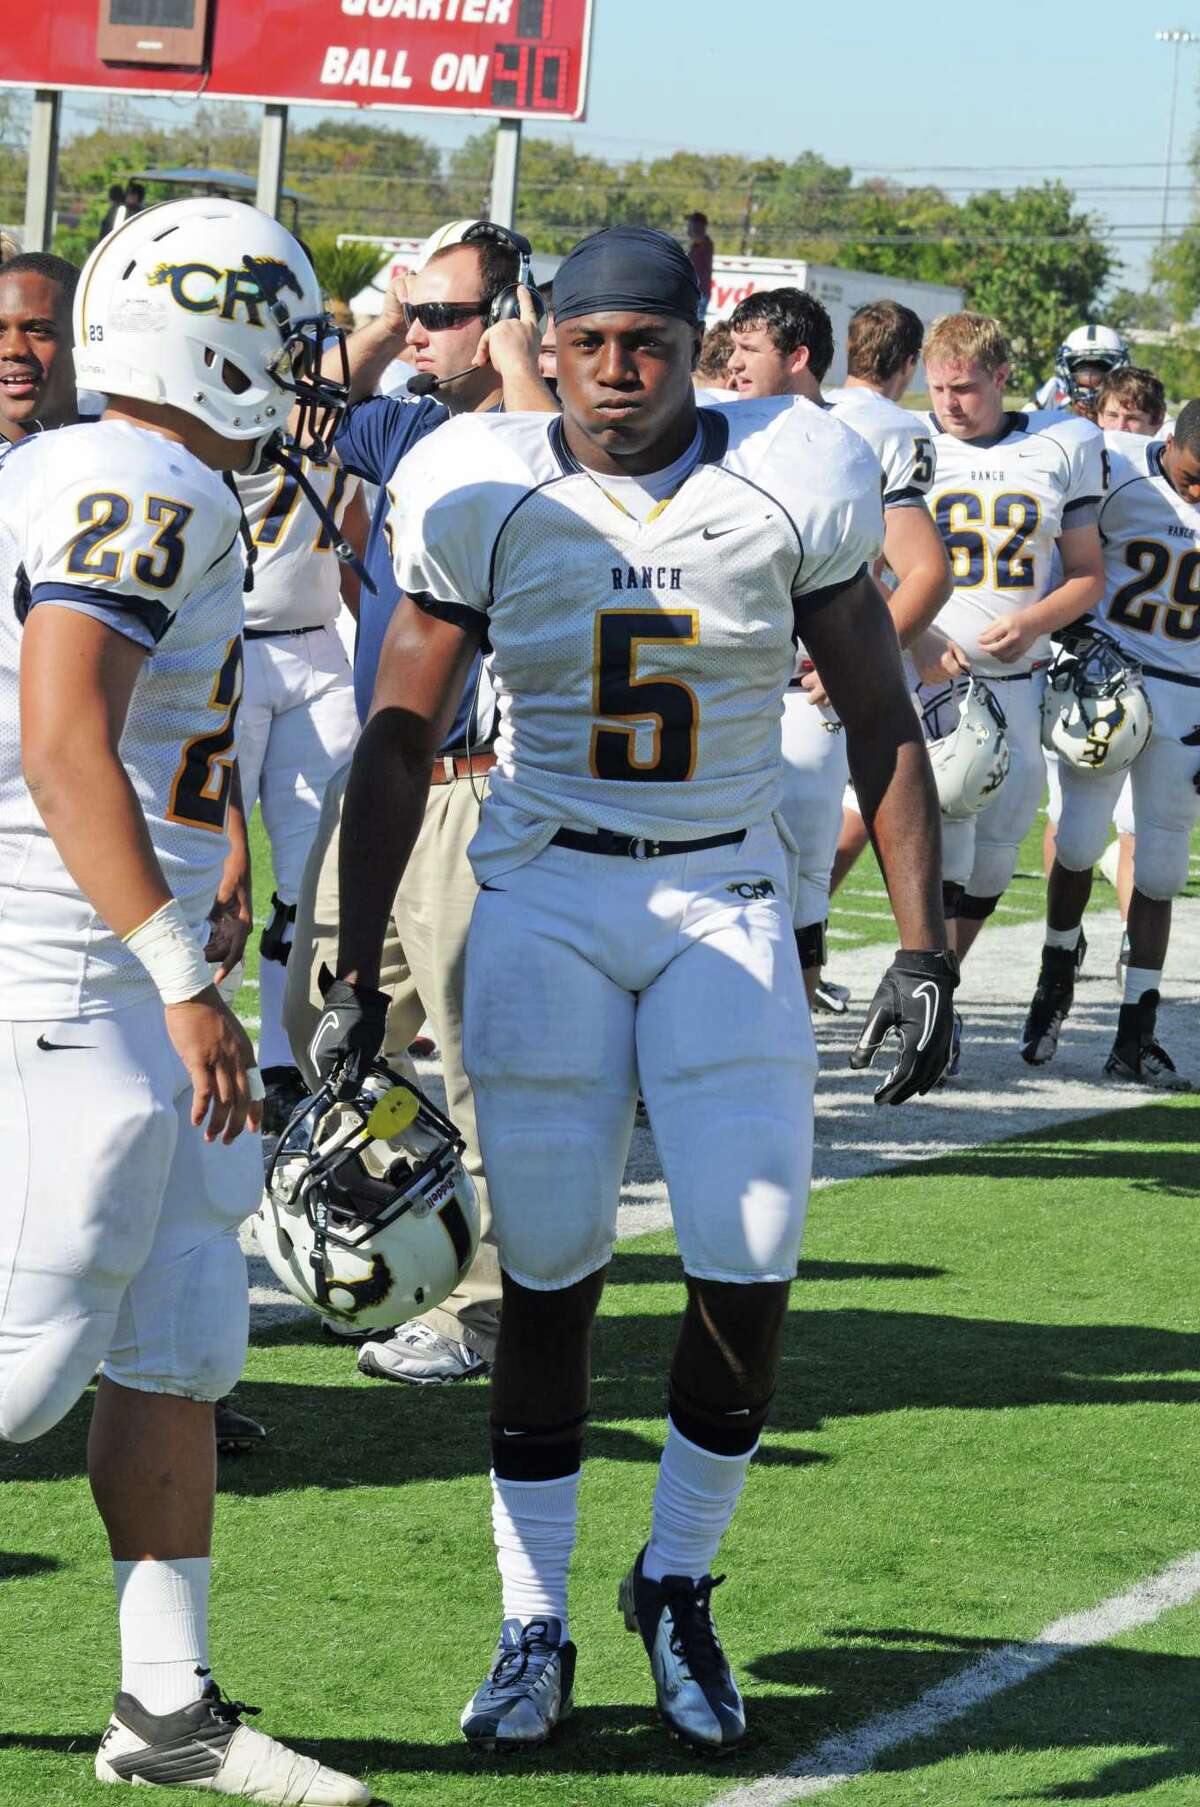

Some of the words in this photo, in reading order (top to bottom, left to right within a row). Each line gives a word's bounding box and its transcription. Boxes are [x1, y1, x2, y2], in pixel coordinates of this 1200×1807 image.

[320, 46, 413, 89] BALL
[430, 53, 489, 93] ON
[493, 46, 568, 109] 40
[89, 325, 104, 342] 23
[971, 471, 1006, 481] RANCH
[66, 489, 194, 592] 23
[931, 488, 1040, 591] 62
[1167, 525, 1196, 540] RANCH
[611, 566, 682, 590] RANCH
[1106, 537, 1200, 643] 29
[589, 608, 699, 782] 5
